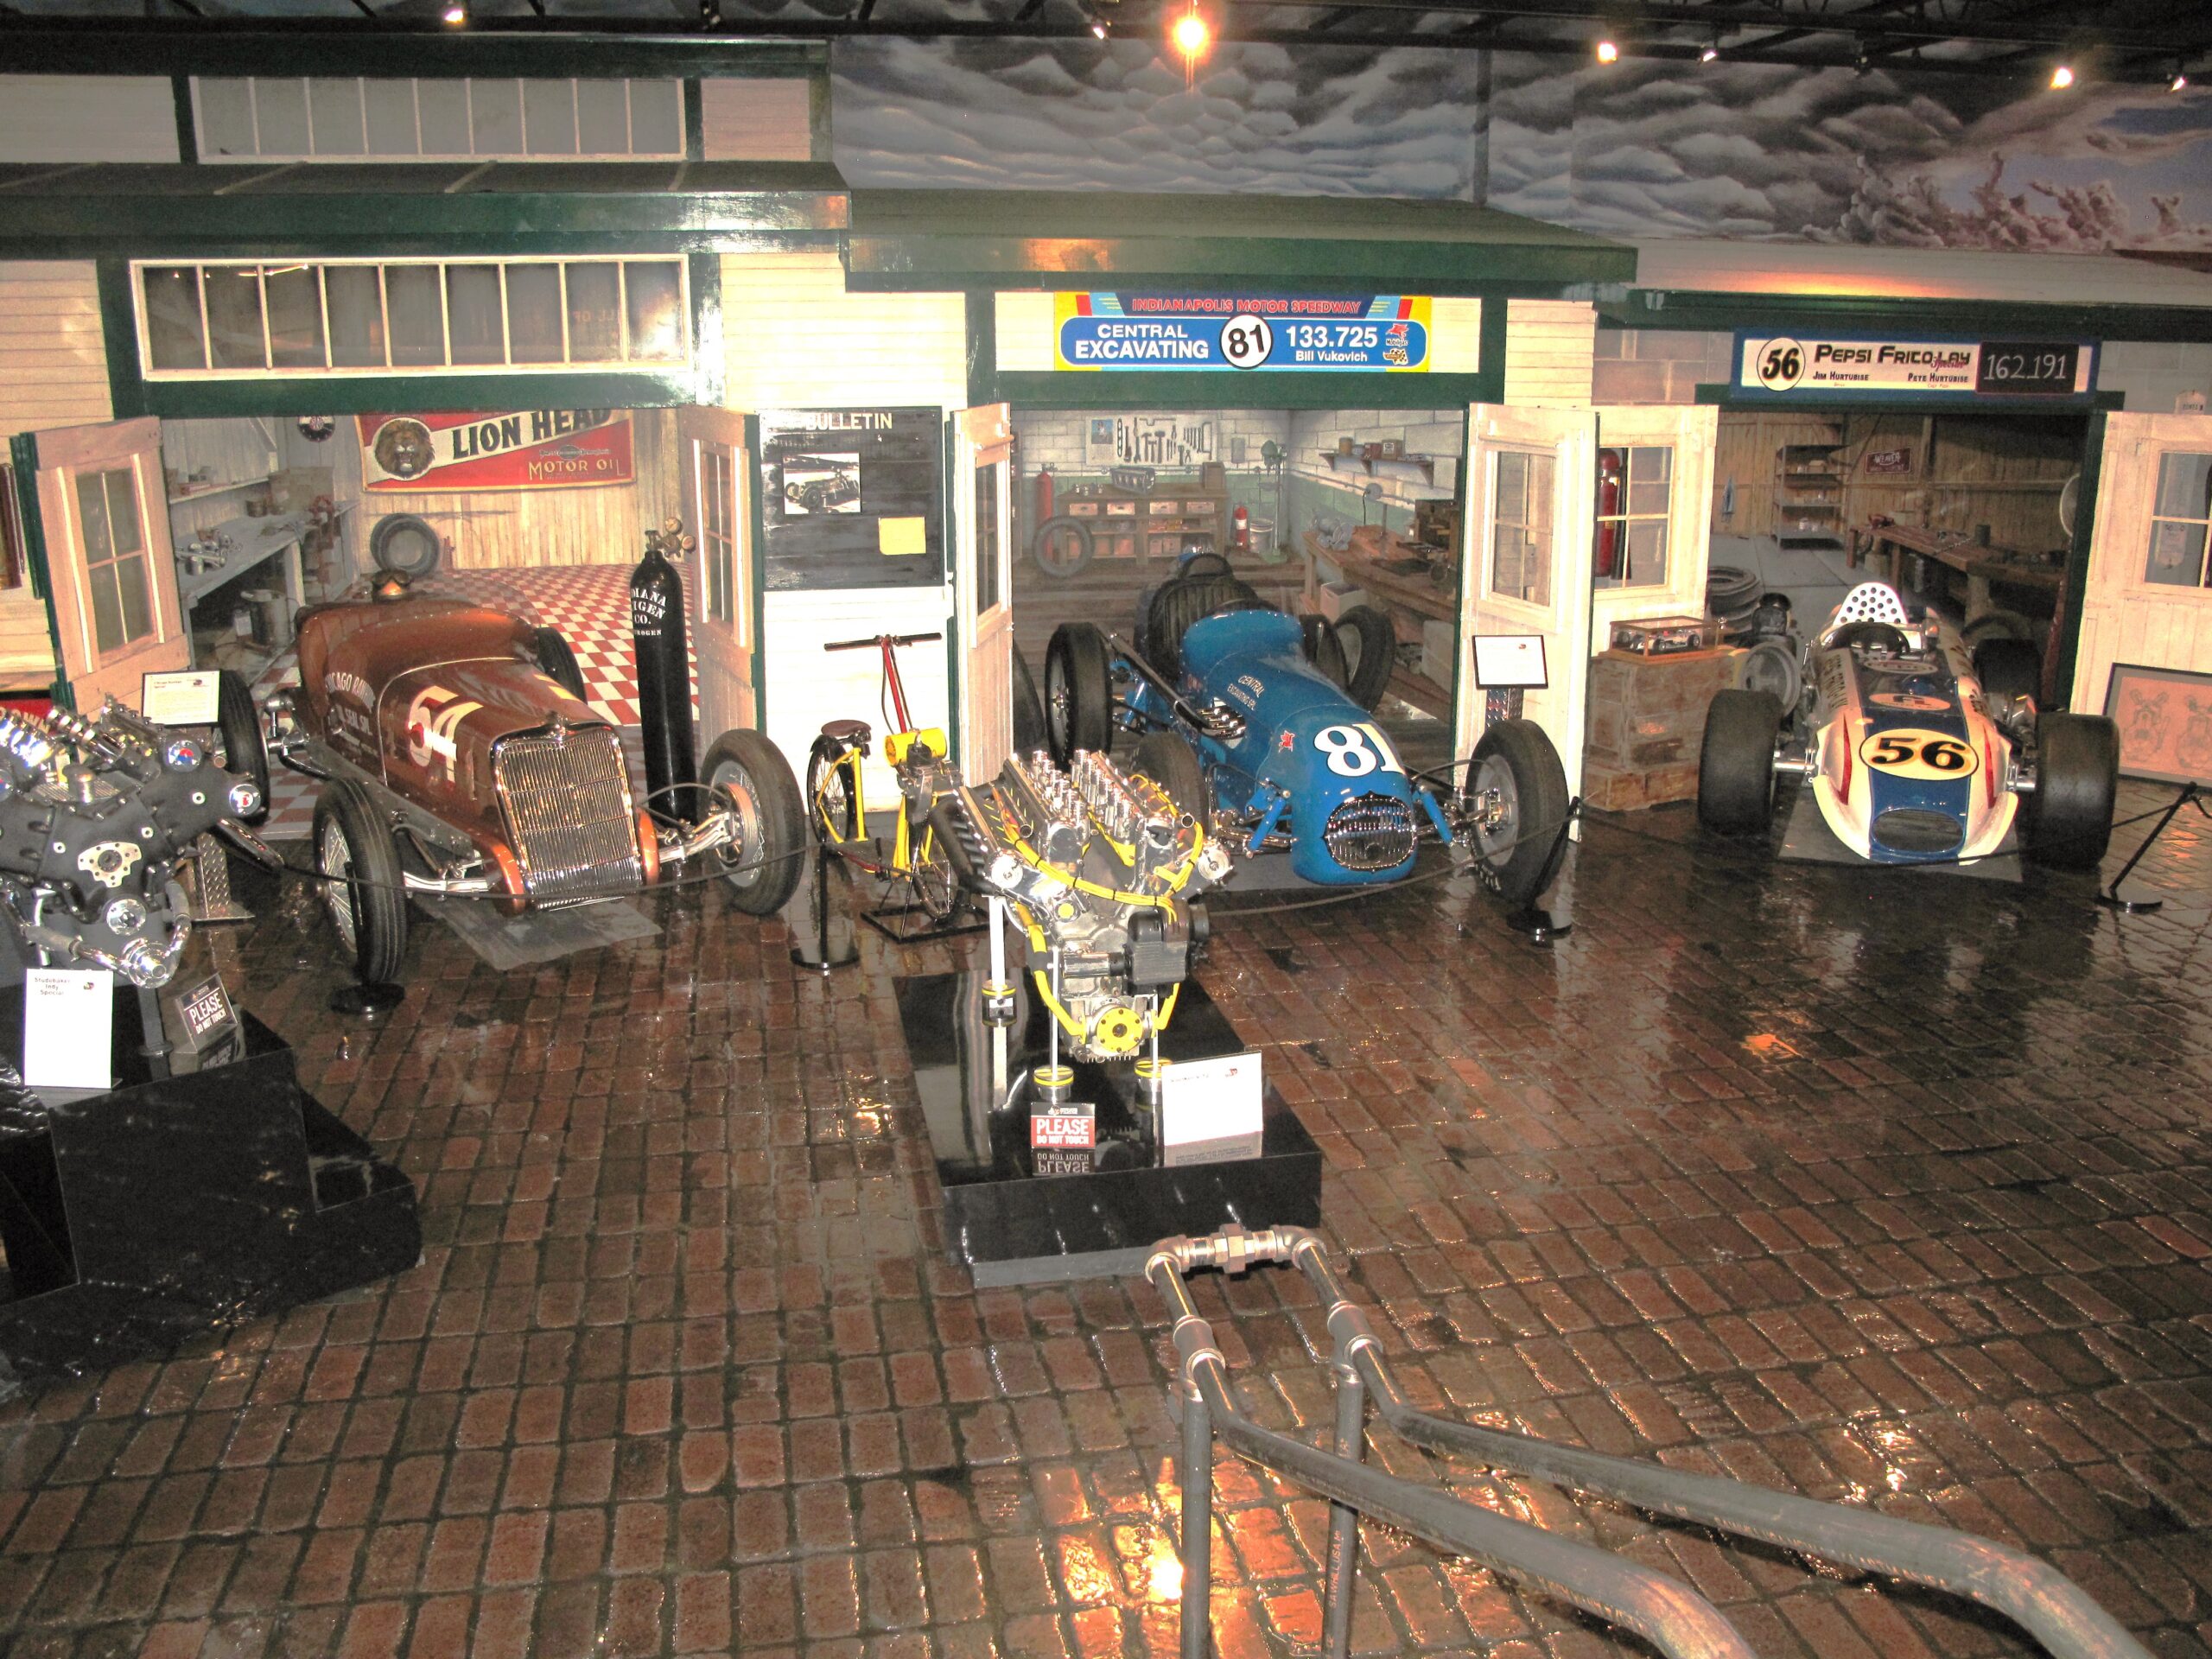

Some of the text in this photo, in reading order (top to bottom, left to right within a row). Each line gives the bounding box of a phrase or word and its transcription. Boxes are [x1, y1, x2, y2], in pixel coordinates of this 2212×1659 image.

[1132, 298, 1361, 314] INDIANAPOLIS MOTOR SPEEDWAY
[1097, 323, 1188, 339] CENTRAL
[1227, 324, 1265, 359] 81
[1286, 326, 1378, 347] 133.725
[1075, 340, 1209, 359] EXCAVATING
[1296, 350, 1368, 363] Bill Vukovich
[1762, 347, 1800, 381] 56
[805, 412, 893, 431] BULLETIN
[452, 415, 522, 461] LION
[528, 460, 588, 480] MOTOR
[596, 459, 626, 476] OIL
[634, 613, 652, 625] CO.
[1237, 675, 1265, 698] CENTRAL
[1313, 723, 1407, 778] 81
[1870, 736, 1971, 772] 56
[189, 993, 223, 1025] PLEASE
[195, 1008, 226, 1034] DO NOT TOUCH
[1036, 1118, 1090, 1135] PLEASE
[1036, 1135, 1090, 1145] DO NOT TOUCH
